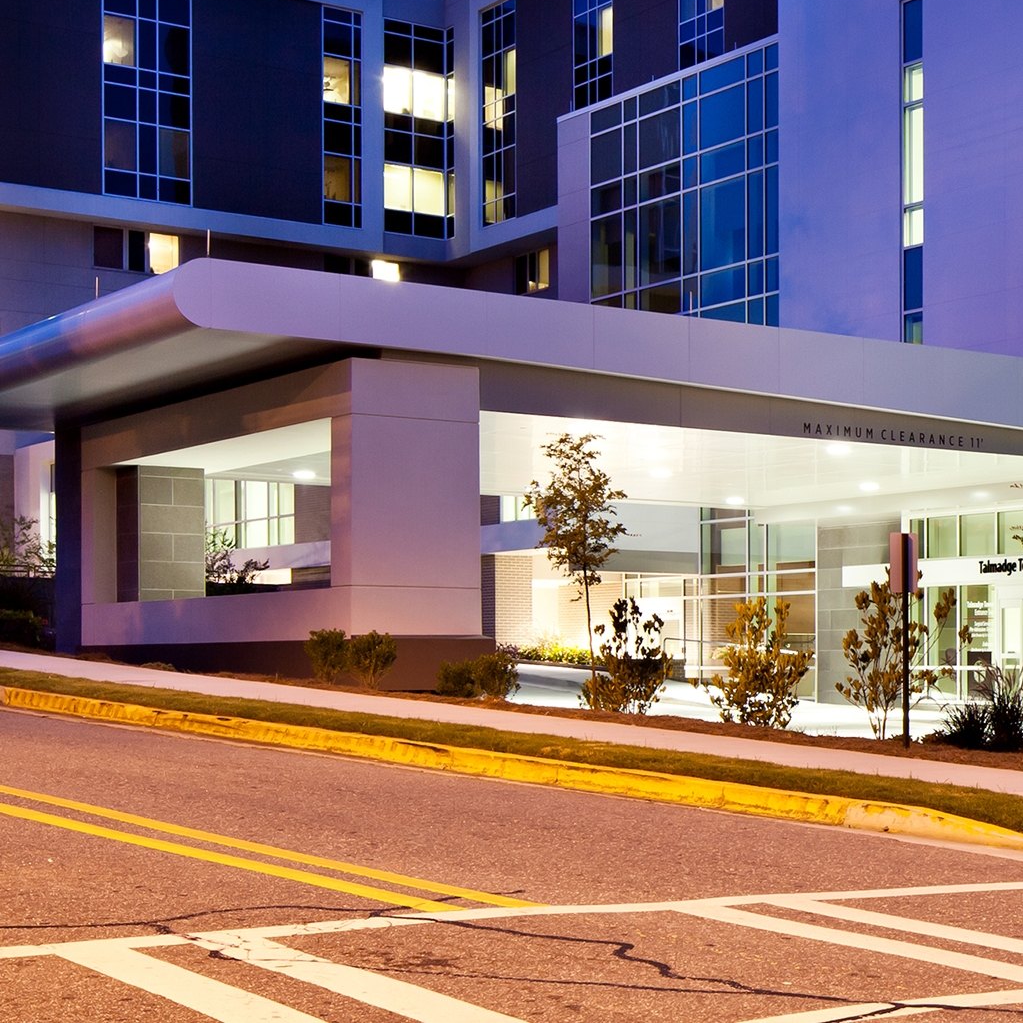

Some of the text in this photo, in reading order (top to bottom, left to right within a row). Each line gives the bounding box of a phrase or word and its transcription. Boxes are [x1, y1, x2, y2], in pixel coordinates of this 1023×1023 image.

[803, 422, 984, 448] MAXIMUM CLEARANCE 11'
[979, 558, 1017, 576] Talmadge
